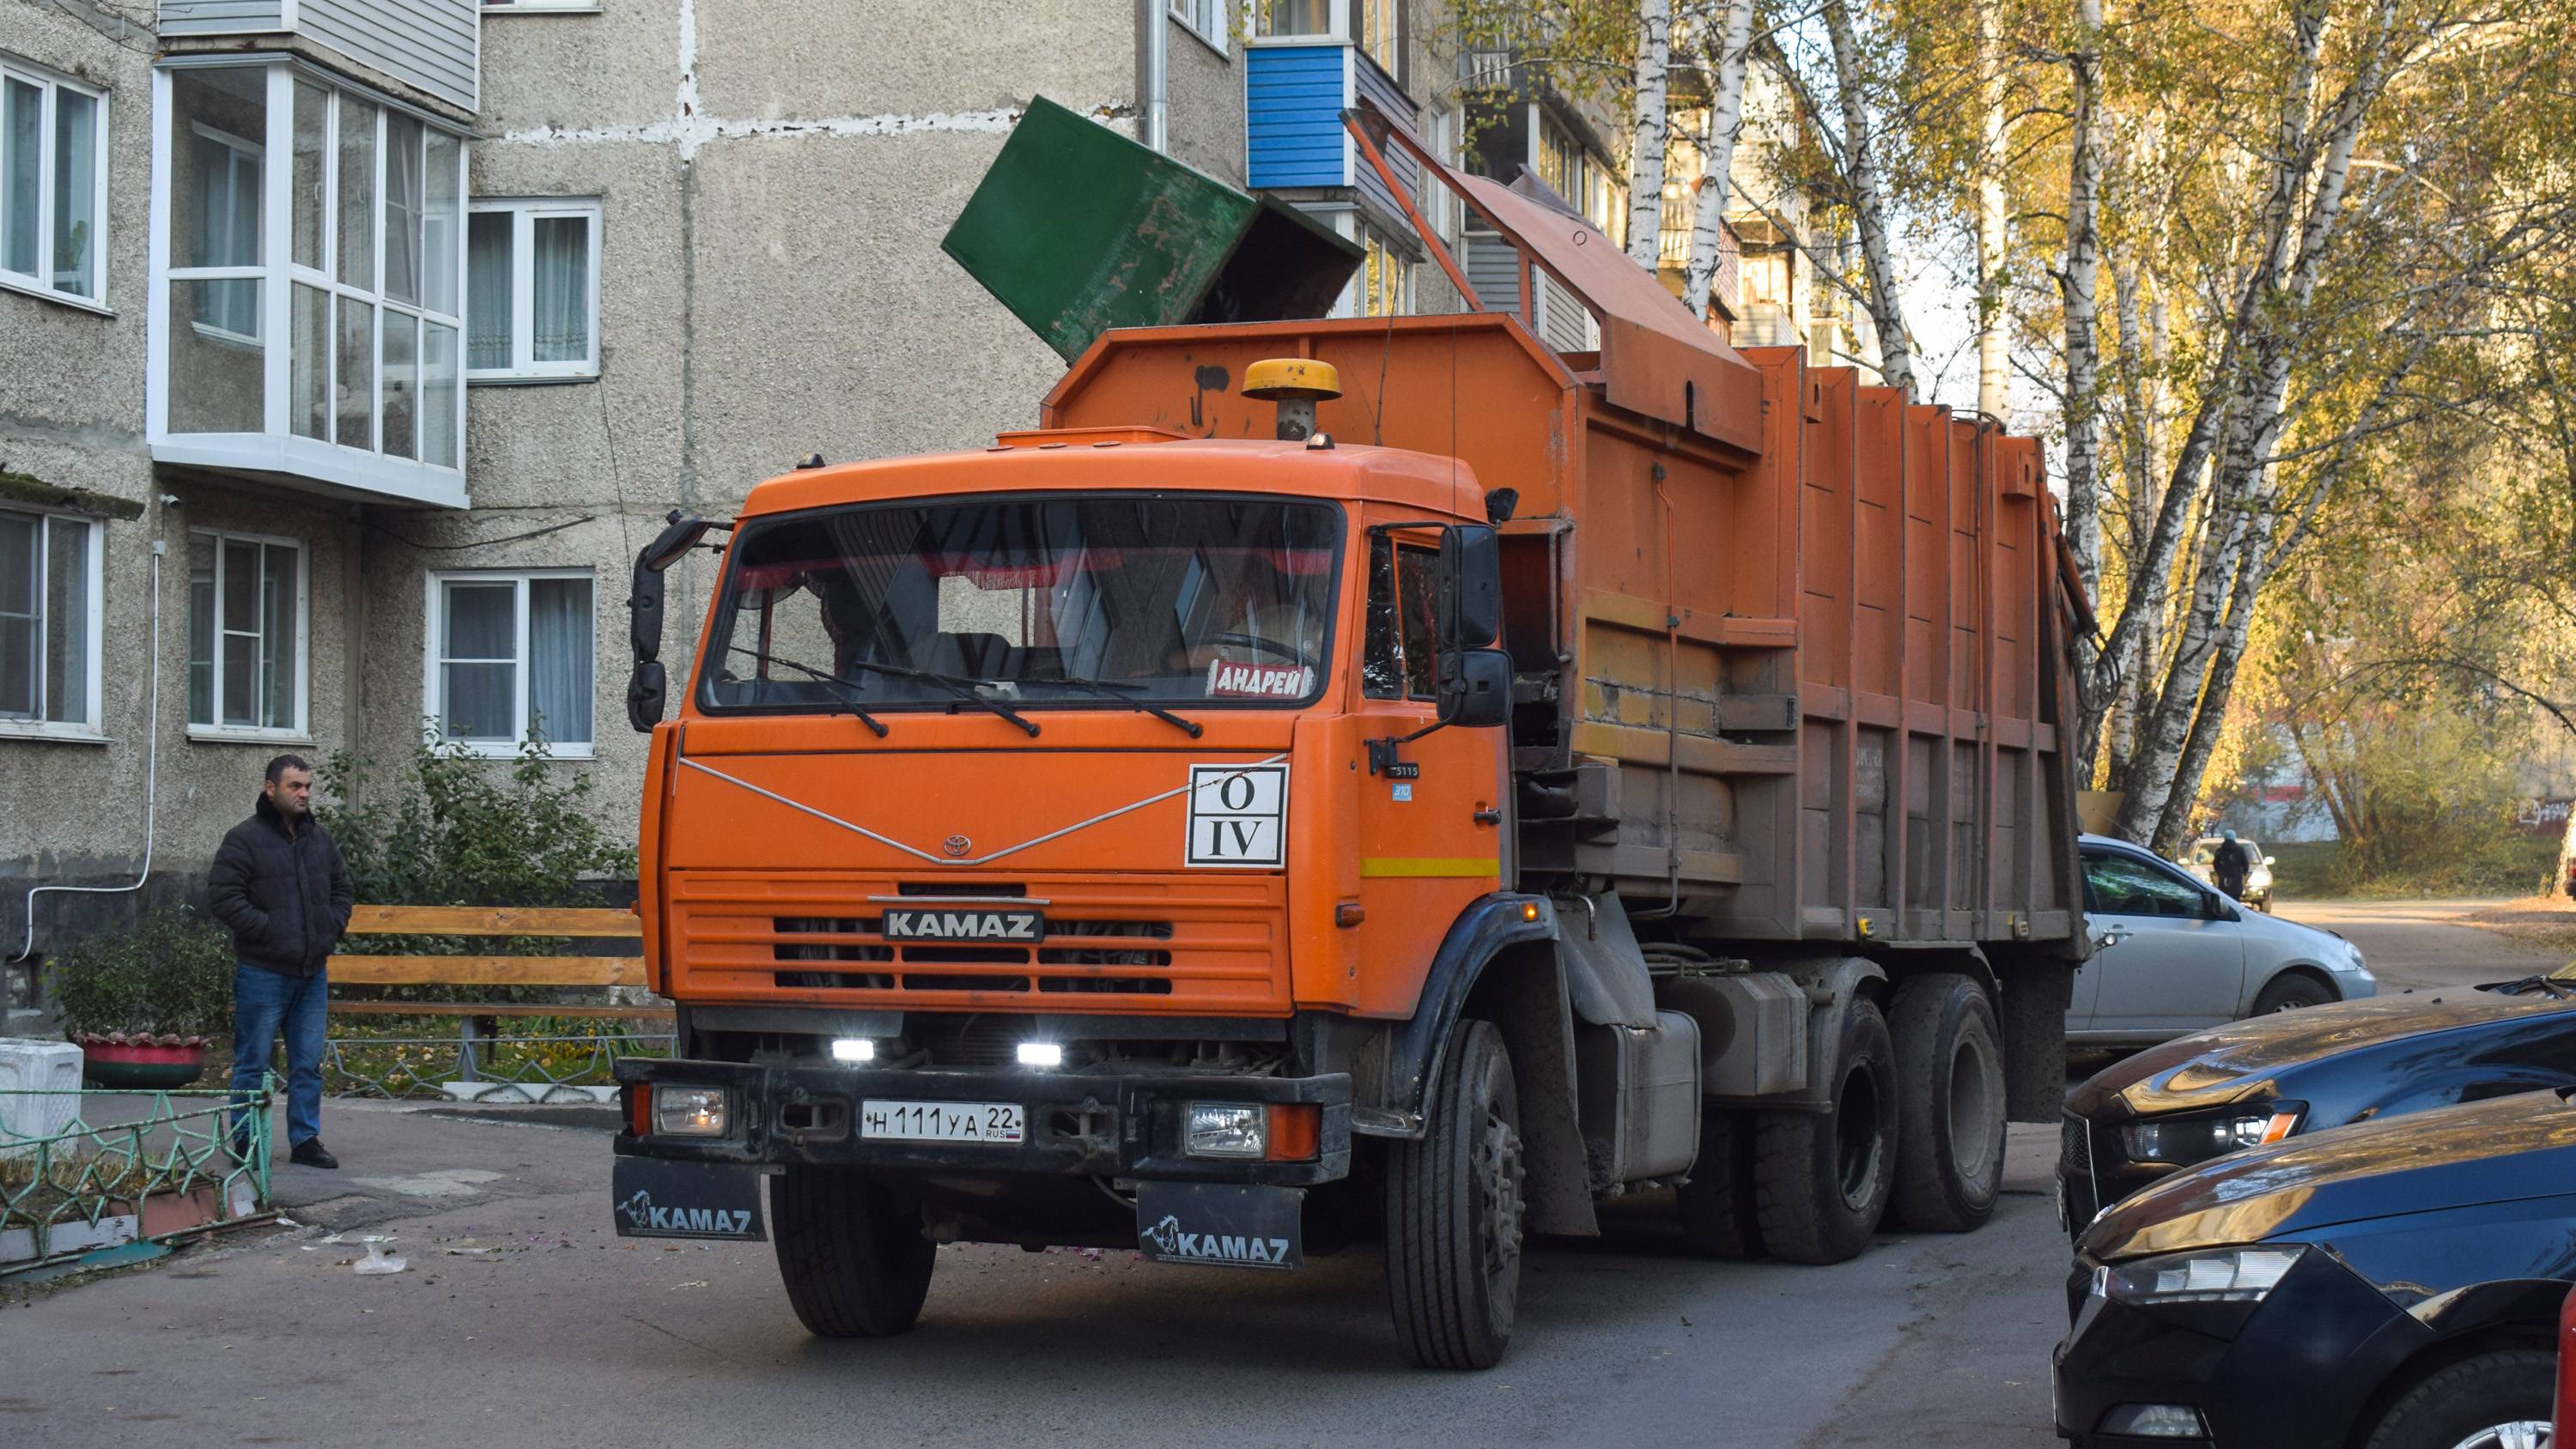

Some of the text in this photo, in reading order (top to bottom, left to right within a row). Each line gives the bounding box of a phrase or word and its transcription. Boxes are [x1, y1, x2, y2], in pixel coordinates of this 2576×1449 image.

[1217, 666, 1300, 695] АНДРЕЙ
[1208, 820, 1263, 857] IV
[889, 912, 1035, 938] KAMAZ
[987, 1107, 1013, 1129] 22
[986, 1130, 1005, 1138] RUS
